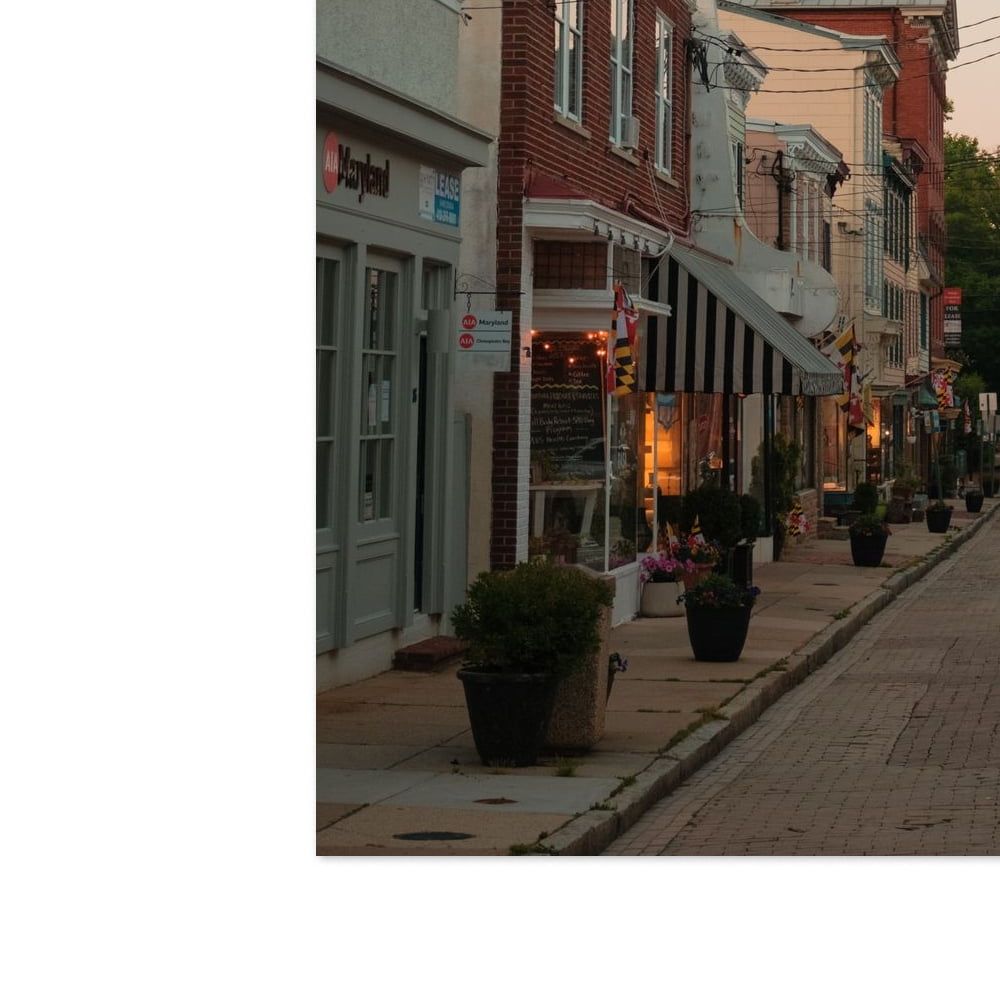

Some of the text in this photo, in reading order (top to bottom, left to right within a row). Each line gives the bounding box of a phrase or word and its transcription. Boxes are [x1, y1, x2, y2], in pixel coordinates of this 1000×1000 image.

[325, 144, 390, 203] AIA Maryland
[436, 172, 460, 202] LEASE
[478, 319, 508, 327] Maryland
[460, 337, 473, 345] AIA
